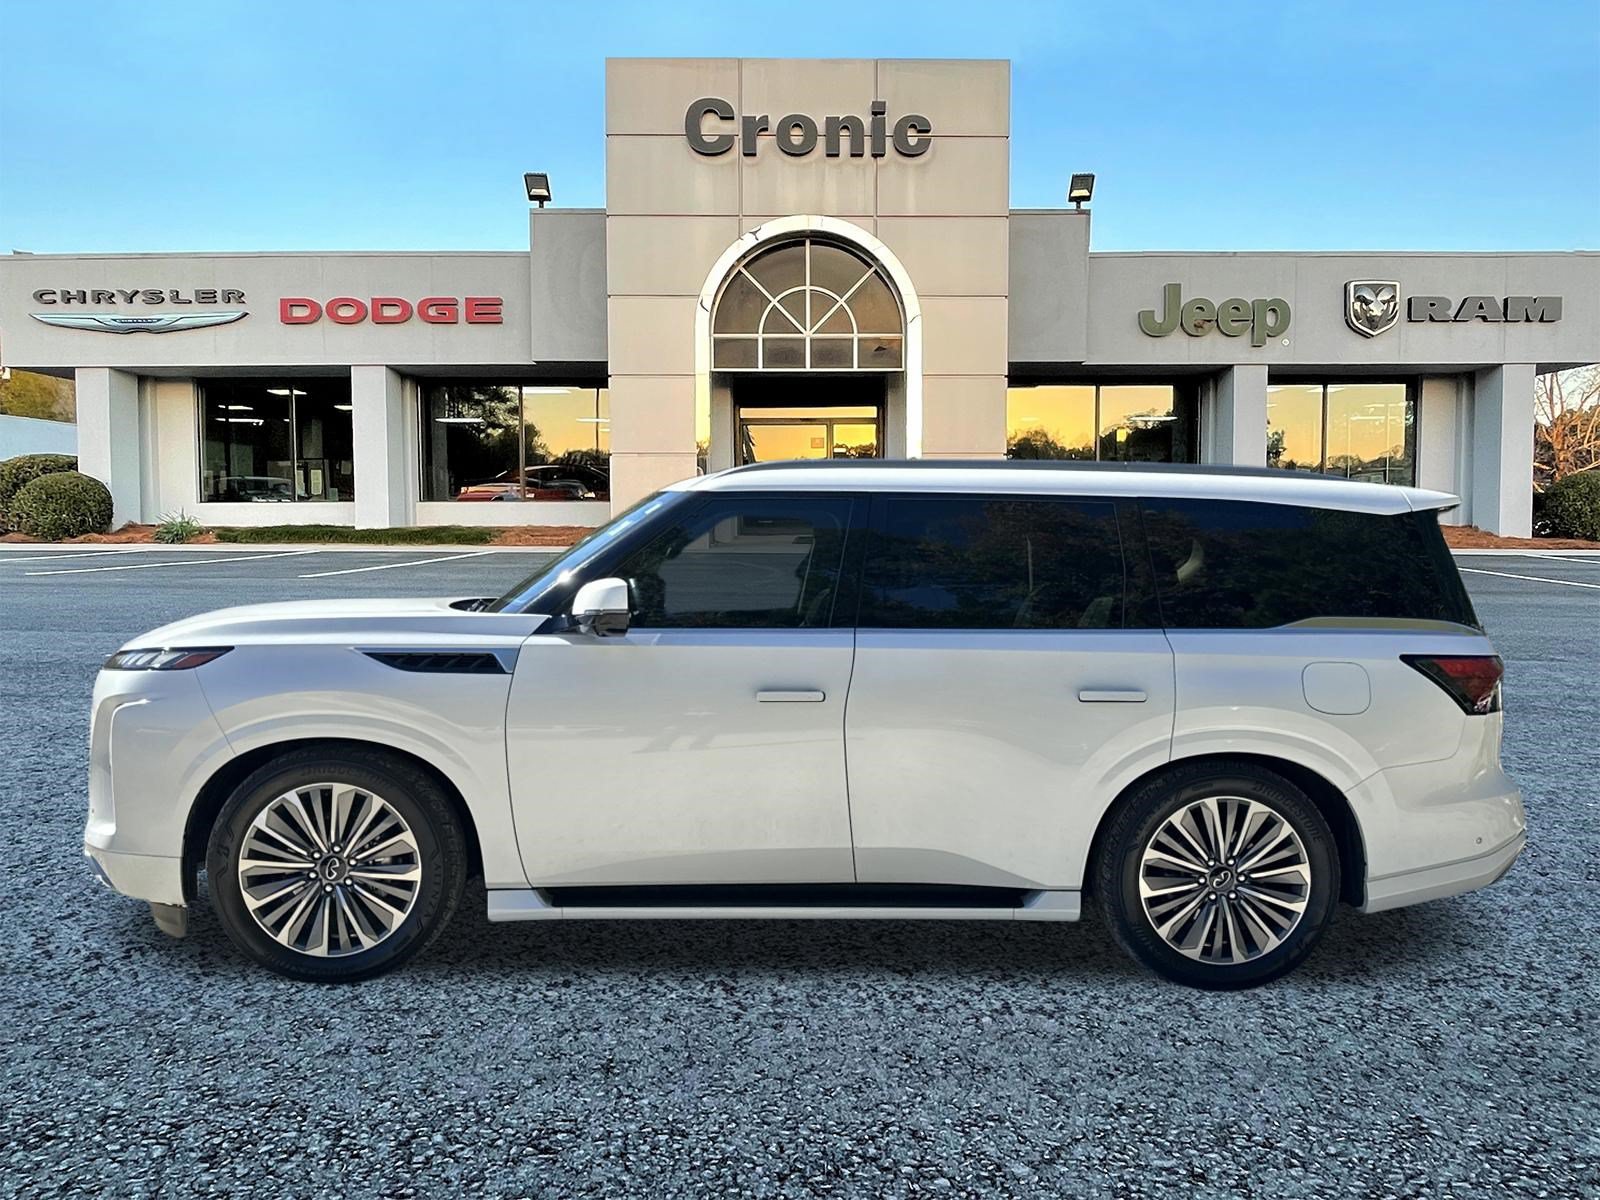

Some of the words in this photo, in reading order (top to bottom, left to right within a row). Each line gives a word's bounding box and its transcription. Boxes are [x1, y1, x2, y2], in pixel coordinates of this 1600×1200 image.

[685, 97, 932, 157] Cronic
[32, 289, 246, 304] CHRYSLER
[1407, 296, 1563, 322] RAM
[279, 297, 503, 324] DODGE
[1138, 283, 1291, 347] Jeep
